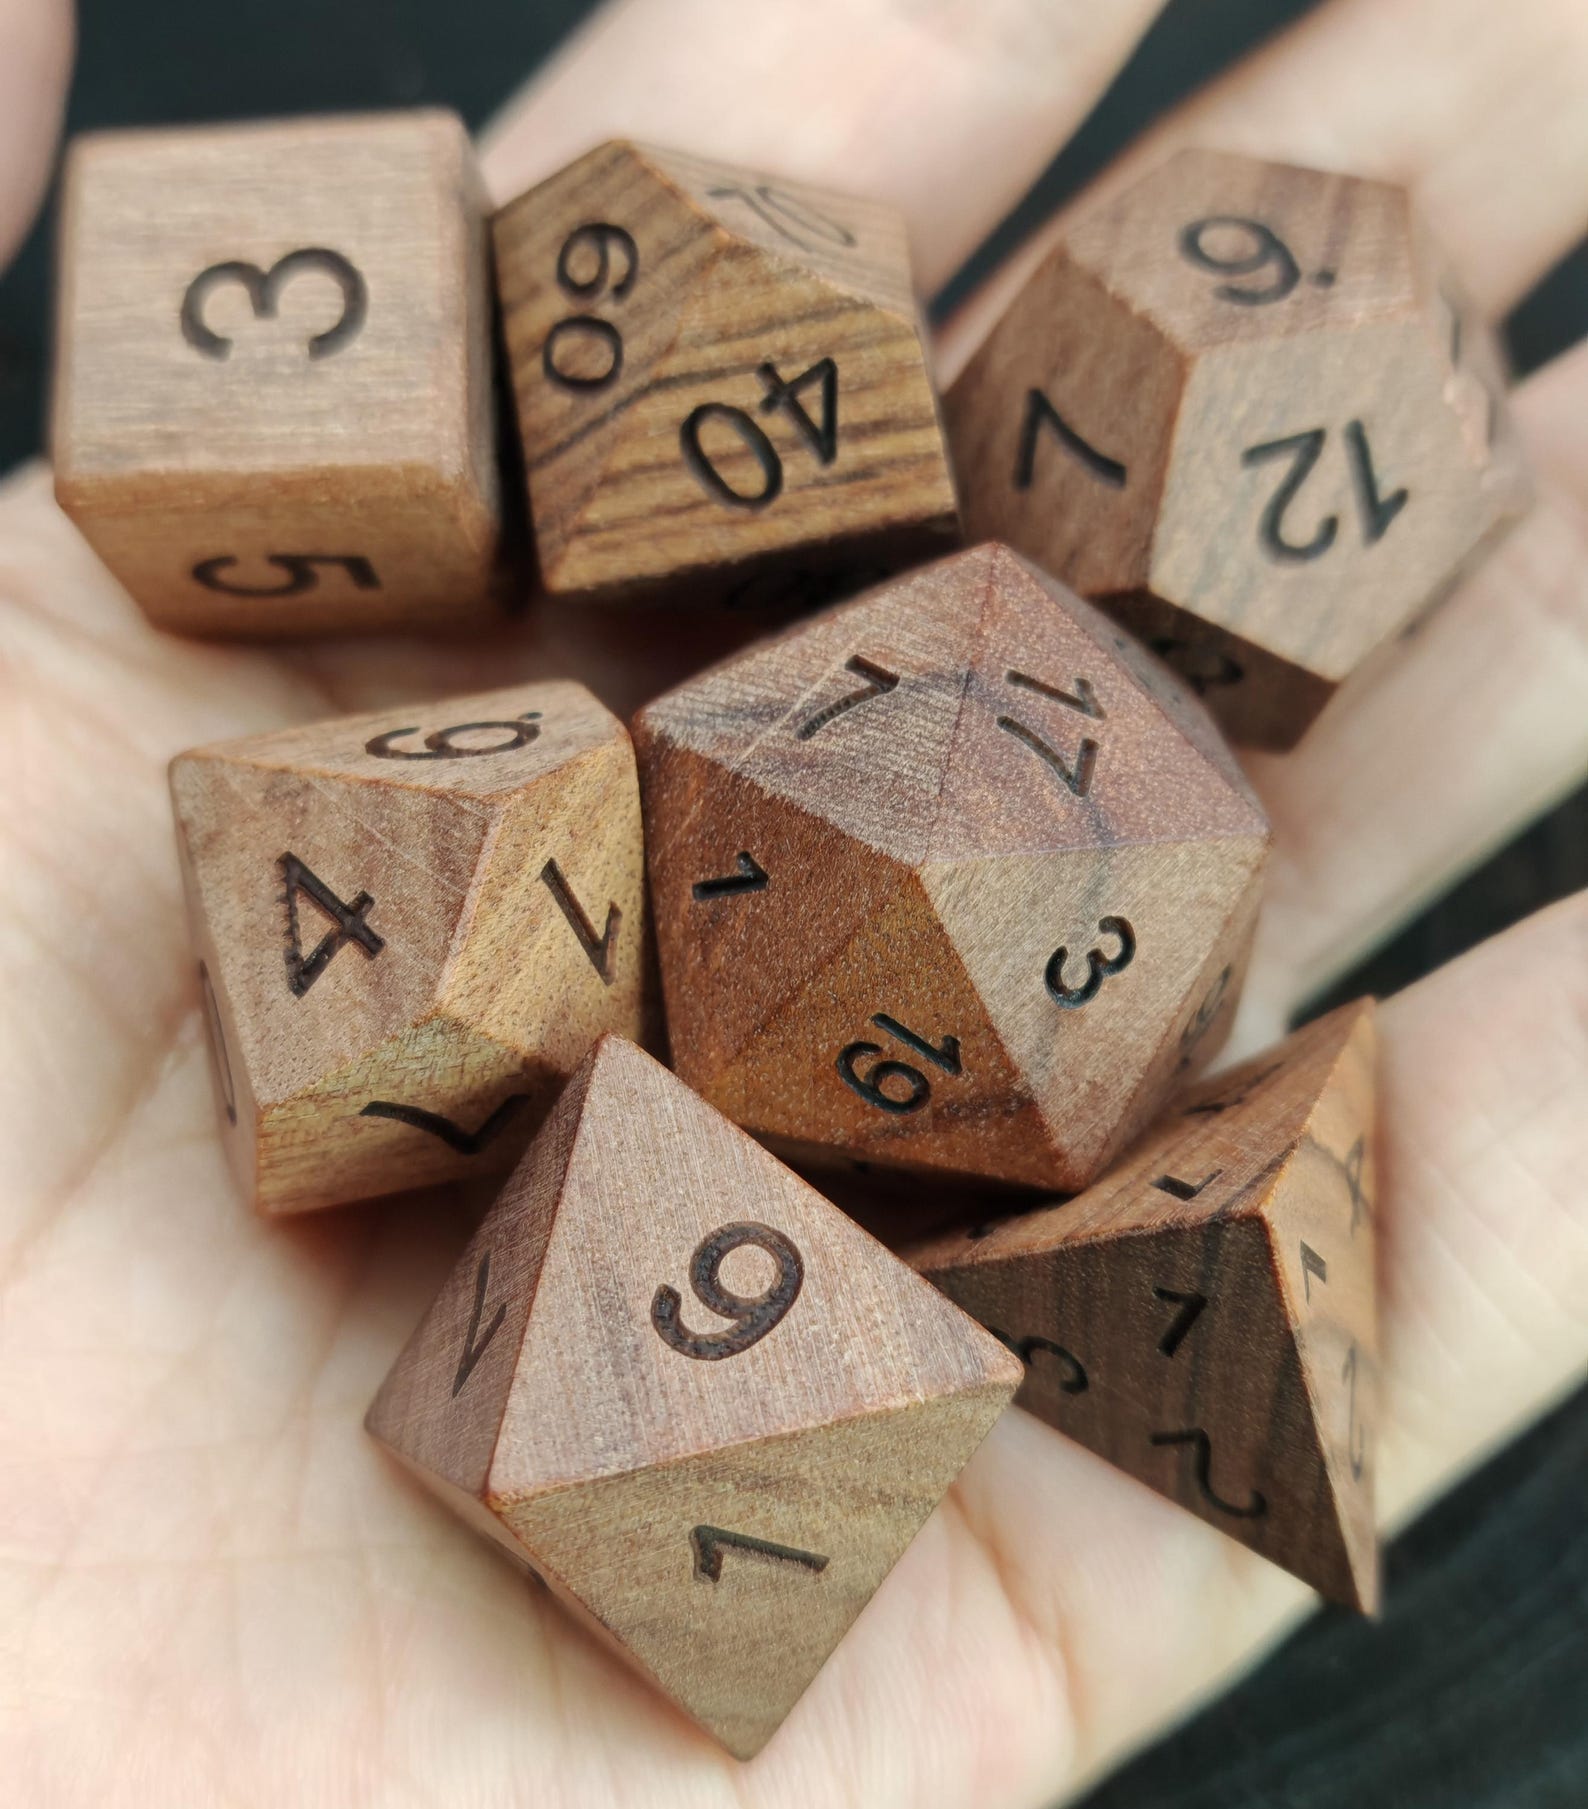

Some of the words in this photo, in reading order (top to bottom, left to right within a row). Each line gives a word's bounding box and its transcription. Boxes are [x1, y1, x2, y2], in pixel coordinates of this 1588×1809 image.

[180, 247, 369, 362] 3
[680, 356, 838, 510] 40
[1014, 388, 1127, 491] 7
[1241, 420, 1409, 565] 12
[191, 553, 383, 598] 5
[799, 655, 900, 741] 7
[998, 669, 1106, 798] 17
[276, 851, 385, 999] 4
[541, 856, 622, 987] 1
[692, 851, 769, 900] 1
[1044, 915, 1136, 1009] 3
[835, 1012, 962, 1115] 19
[1154, 1286, 1209, 1359] 1
[1149, 1428, 1268, 1519] 2
